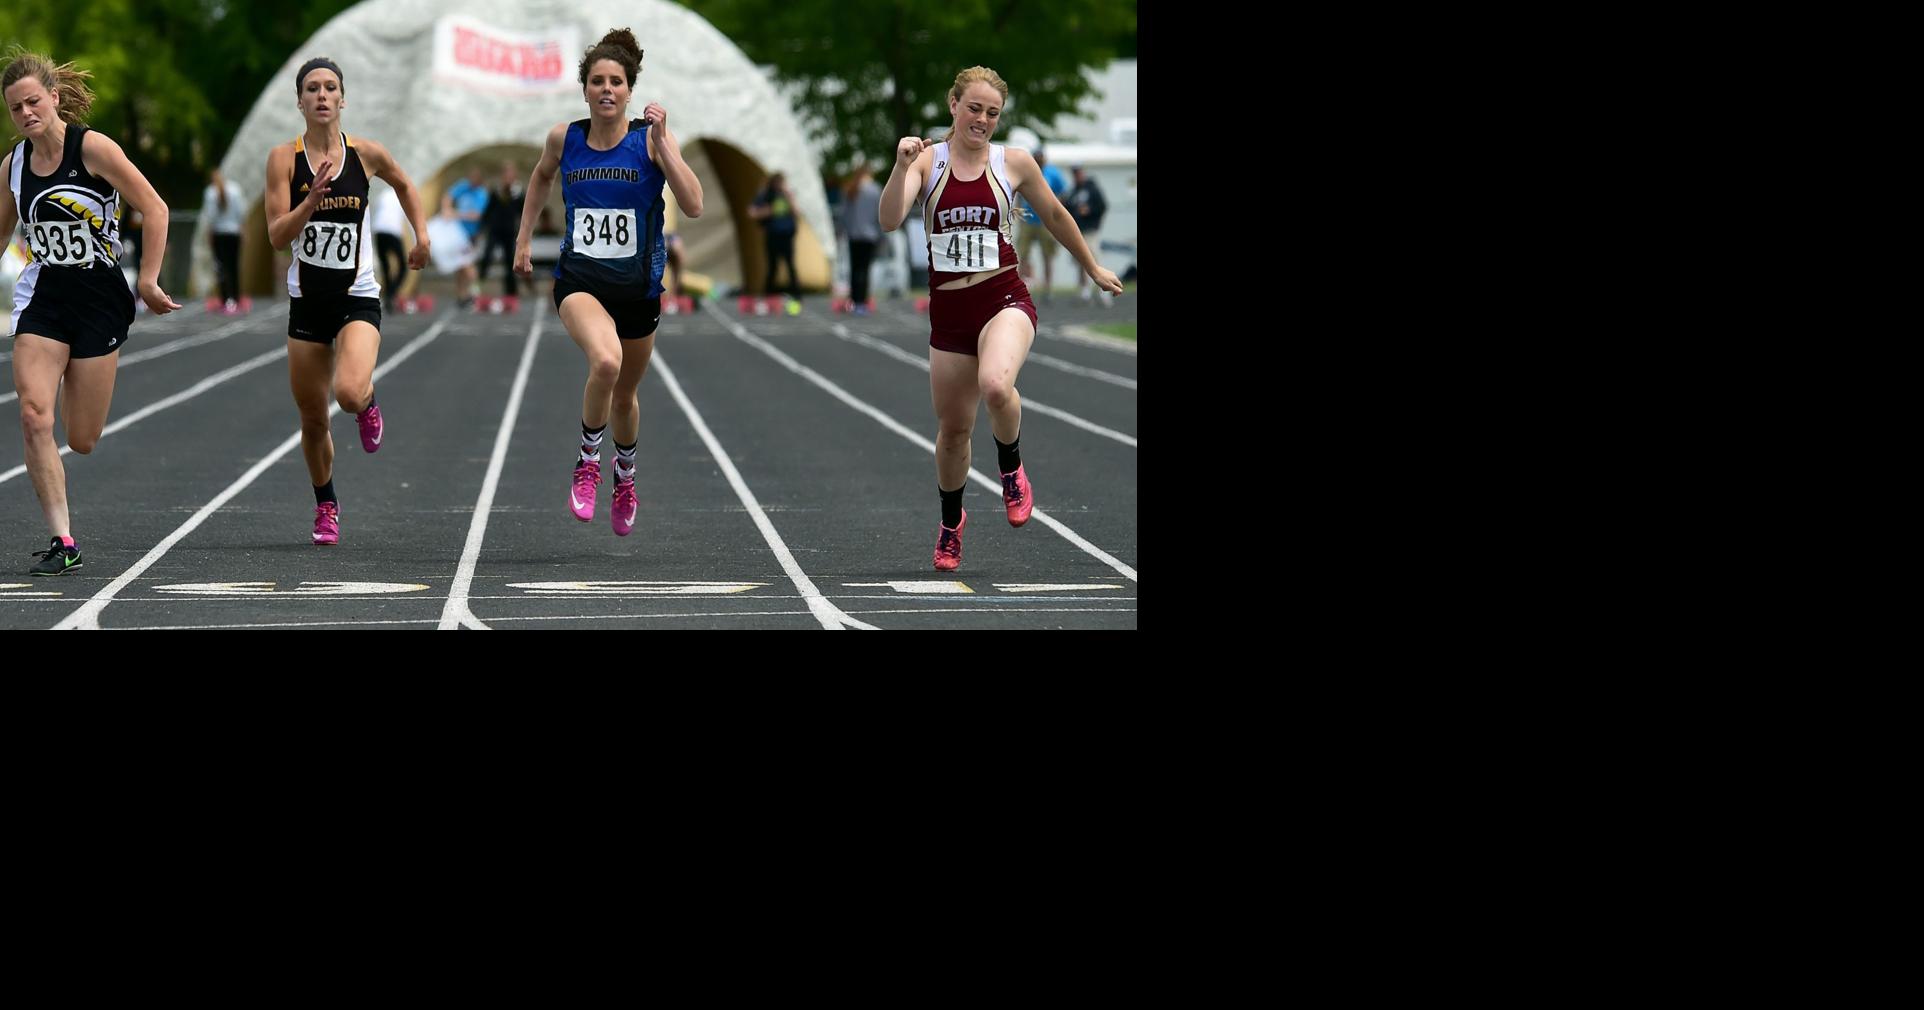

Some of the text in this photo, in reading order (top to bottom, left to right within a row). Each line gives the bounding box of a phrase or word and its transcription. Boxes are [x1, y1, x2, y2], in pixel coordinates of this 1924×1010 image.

[567, 167, 640, 185] DRUMMOND
[316, 195, 360, 211] UNDER
[938, 206, 996, 227] FORT
[33, 224, 87, 262] 935
[303, 225, 352, 262] 878
[583, 214, 629, 246] 348
[946, 234, 984, 267] 411
